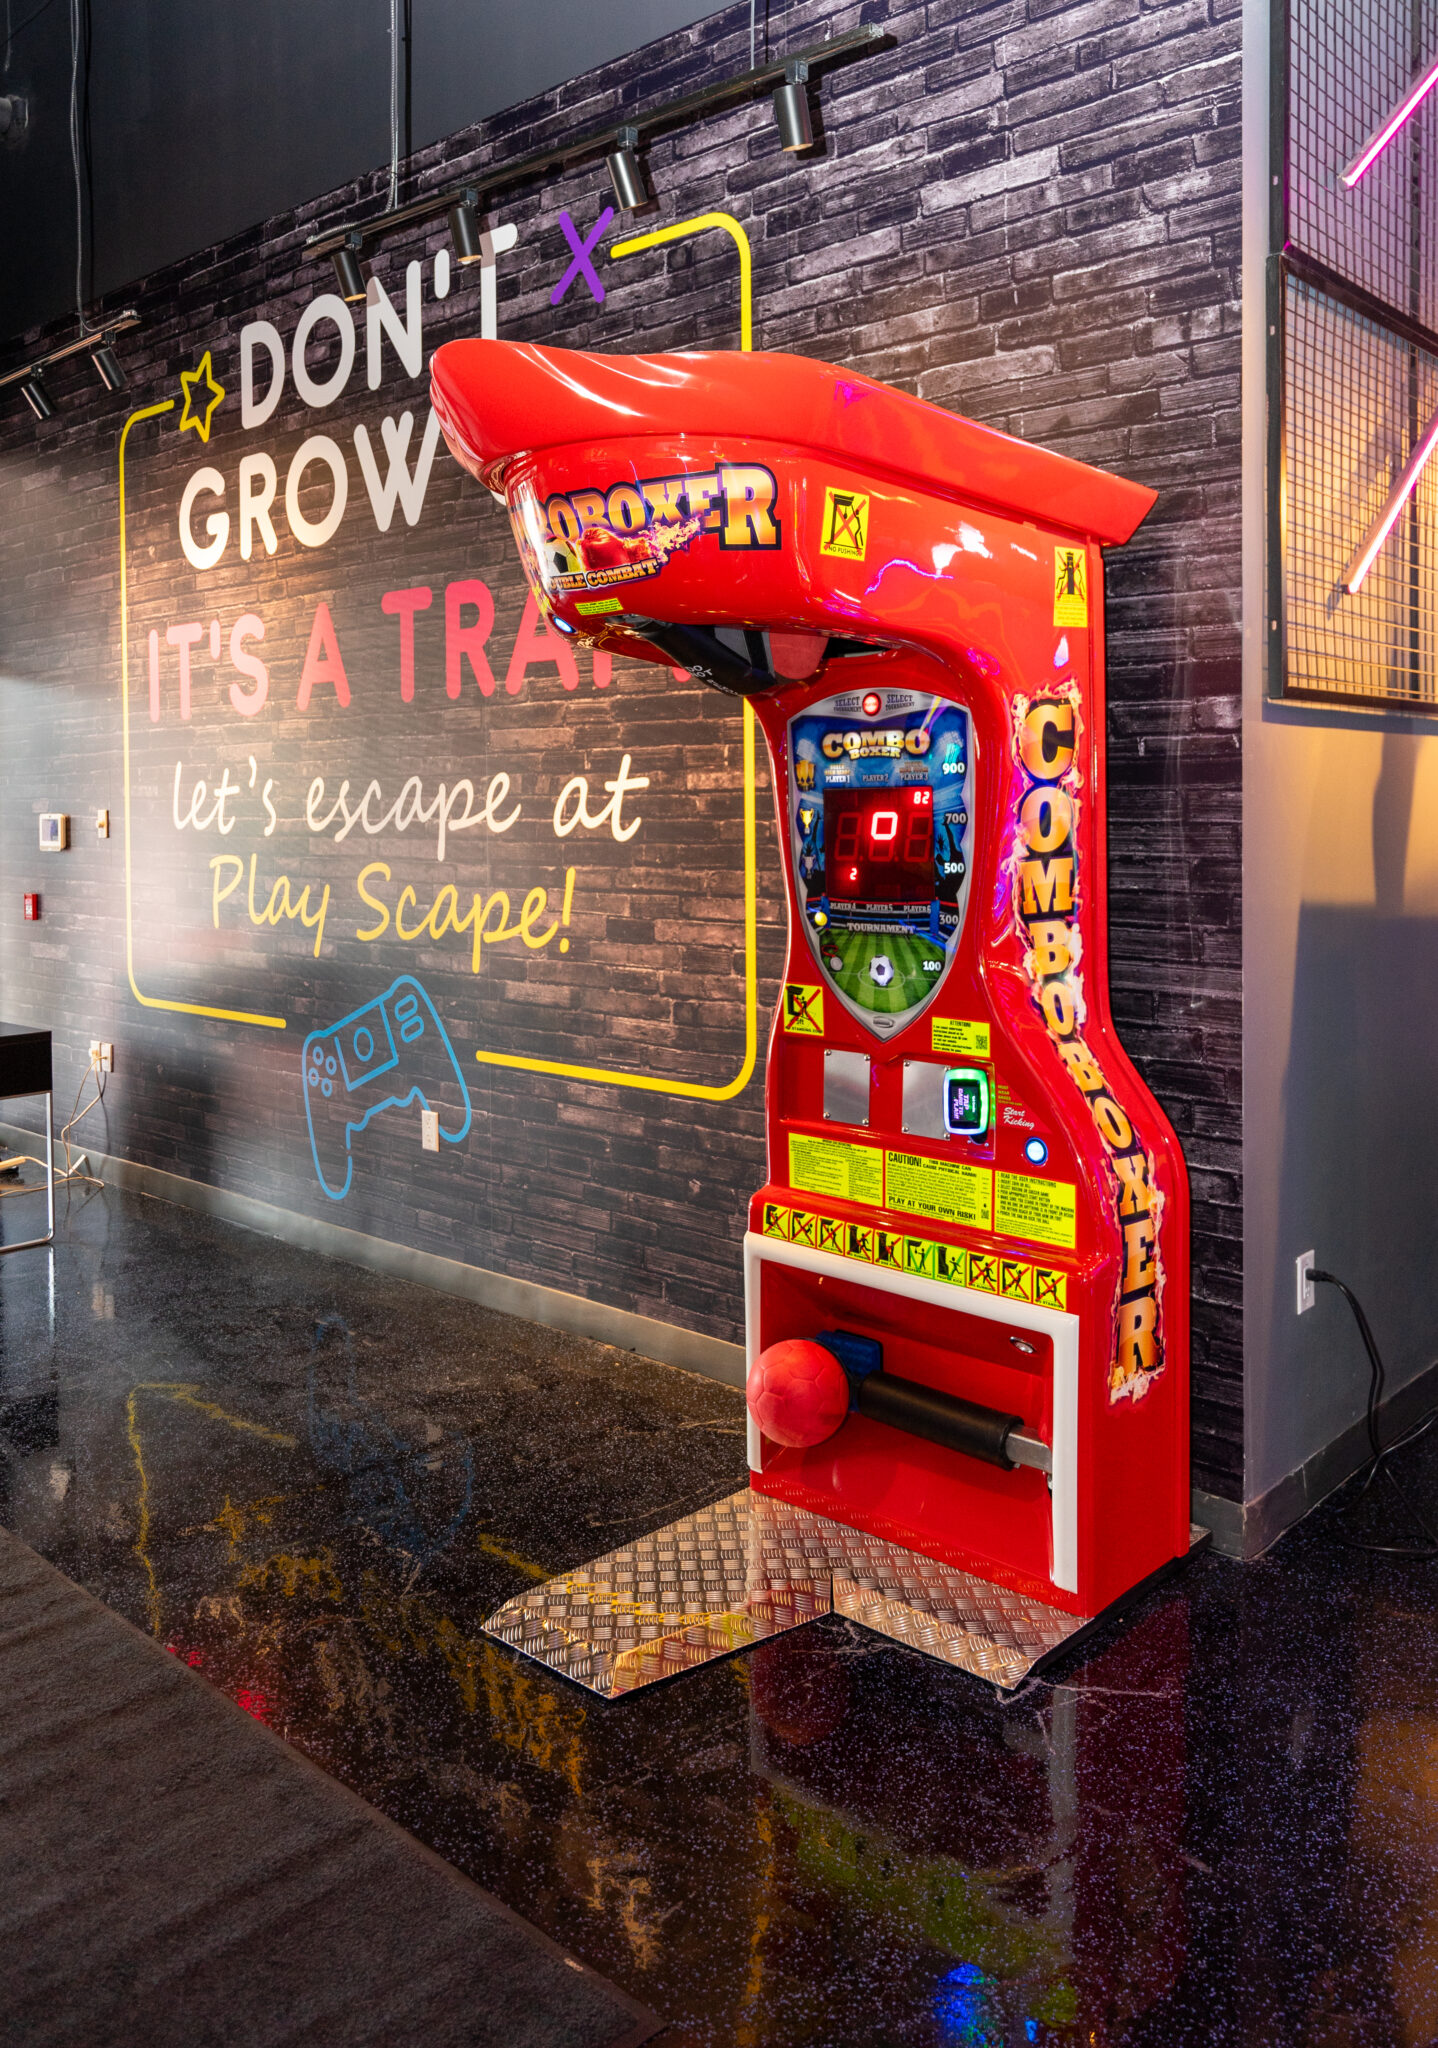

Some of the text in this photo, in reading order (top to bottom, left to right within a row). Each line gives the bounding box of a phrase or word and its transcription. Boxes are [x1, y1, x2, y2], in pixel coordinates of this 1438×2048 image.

[240, 223, 518, 429] DON'T
[179, 407, 439, 570] GROW
[550, 560, 657, 590] OUBLE COMBAT
[149, 579, 691, 723] IT'S A TRA
[835, 696, 860, 706] SELECT
[887, 694, 913, 703] SELECT
[822, 728, 930, 758] COMBO
[849, 746, 901, 760] BOXER
[942, 762, 965, 775] 900
[826, 775, 846, 783] PLAYER
[913, 791, 930, 805] 82
[173, 753, 650, 861] let's escape at
[945, 812, 967, 824] 700
[944, 862, 965, 874] 500
[209, 853, 576, 973] Play Scape!
[904, 905, 925, 913] PLAYER
[939, 915, 959, 924] 300
[847, 922, 916, 934] TOURNAMENT
[923, 961, 941, 971] 100
[1003, 1106, 1025, 1117] Start
[1003, 1115, 1034, 1130] Kicking
[889, 1152, 921, 1167] CAUTION!
[889, 1196, 905, 1205] PLAY
[918, 1202, 935, 1211] YOUR
[939, 1207, 955, 1215] OWN
[957, 1210, 975, 1220] RISK!
